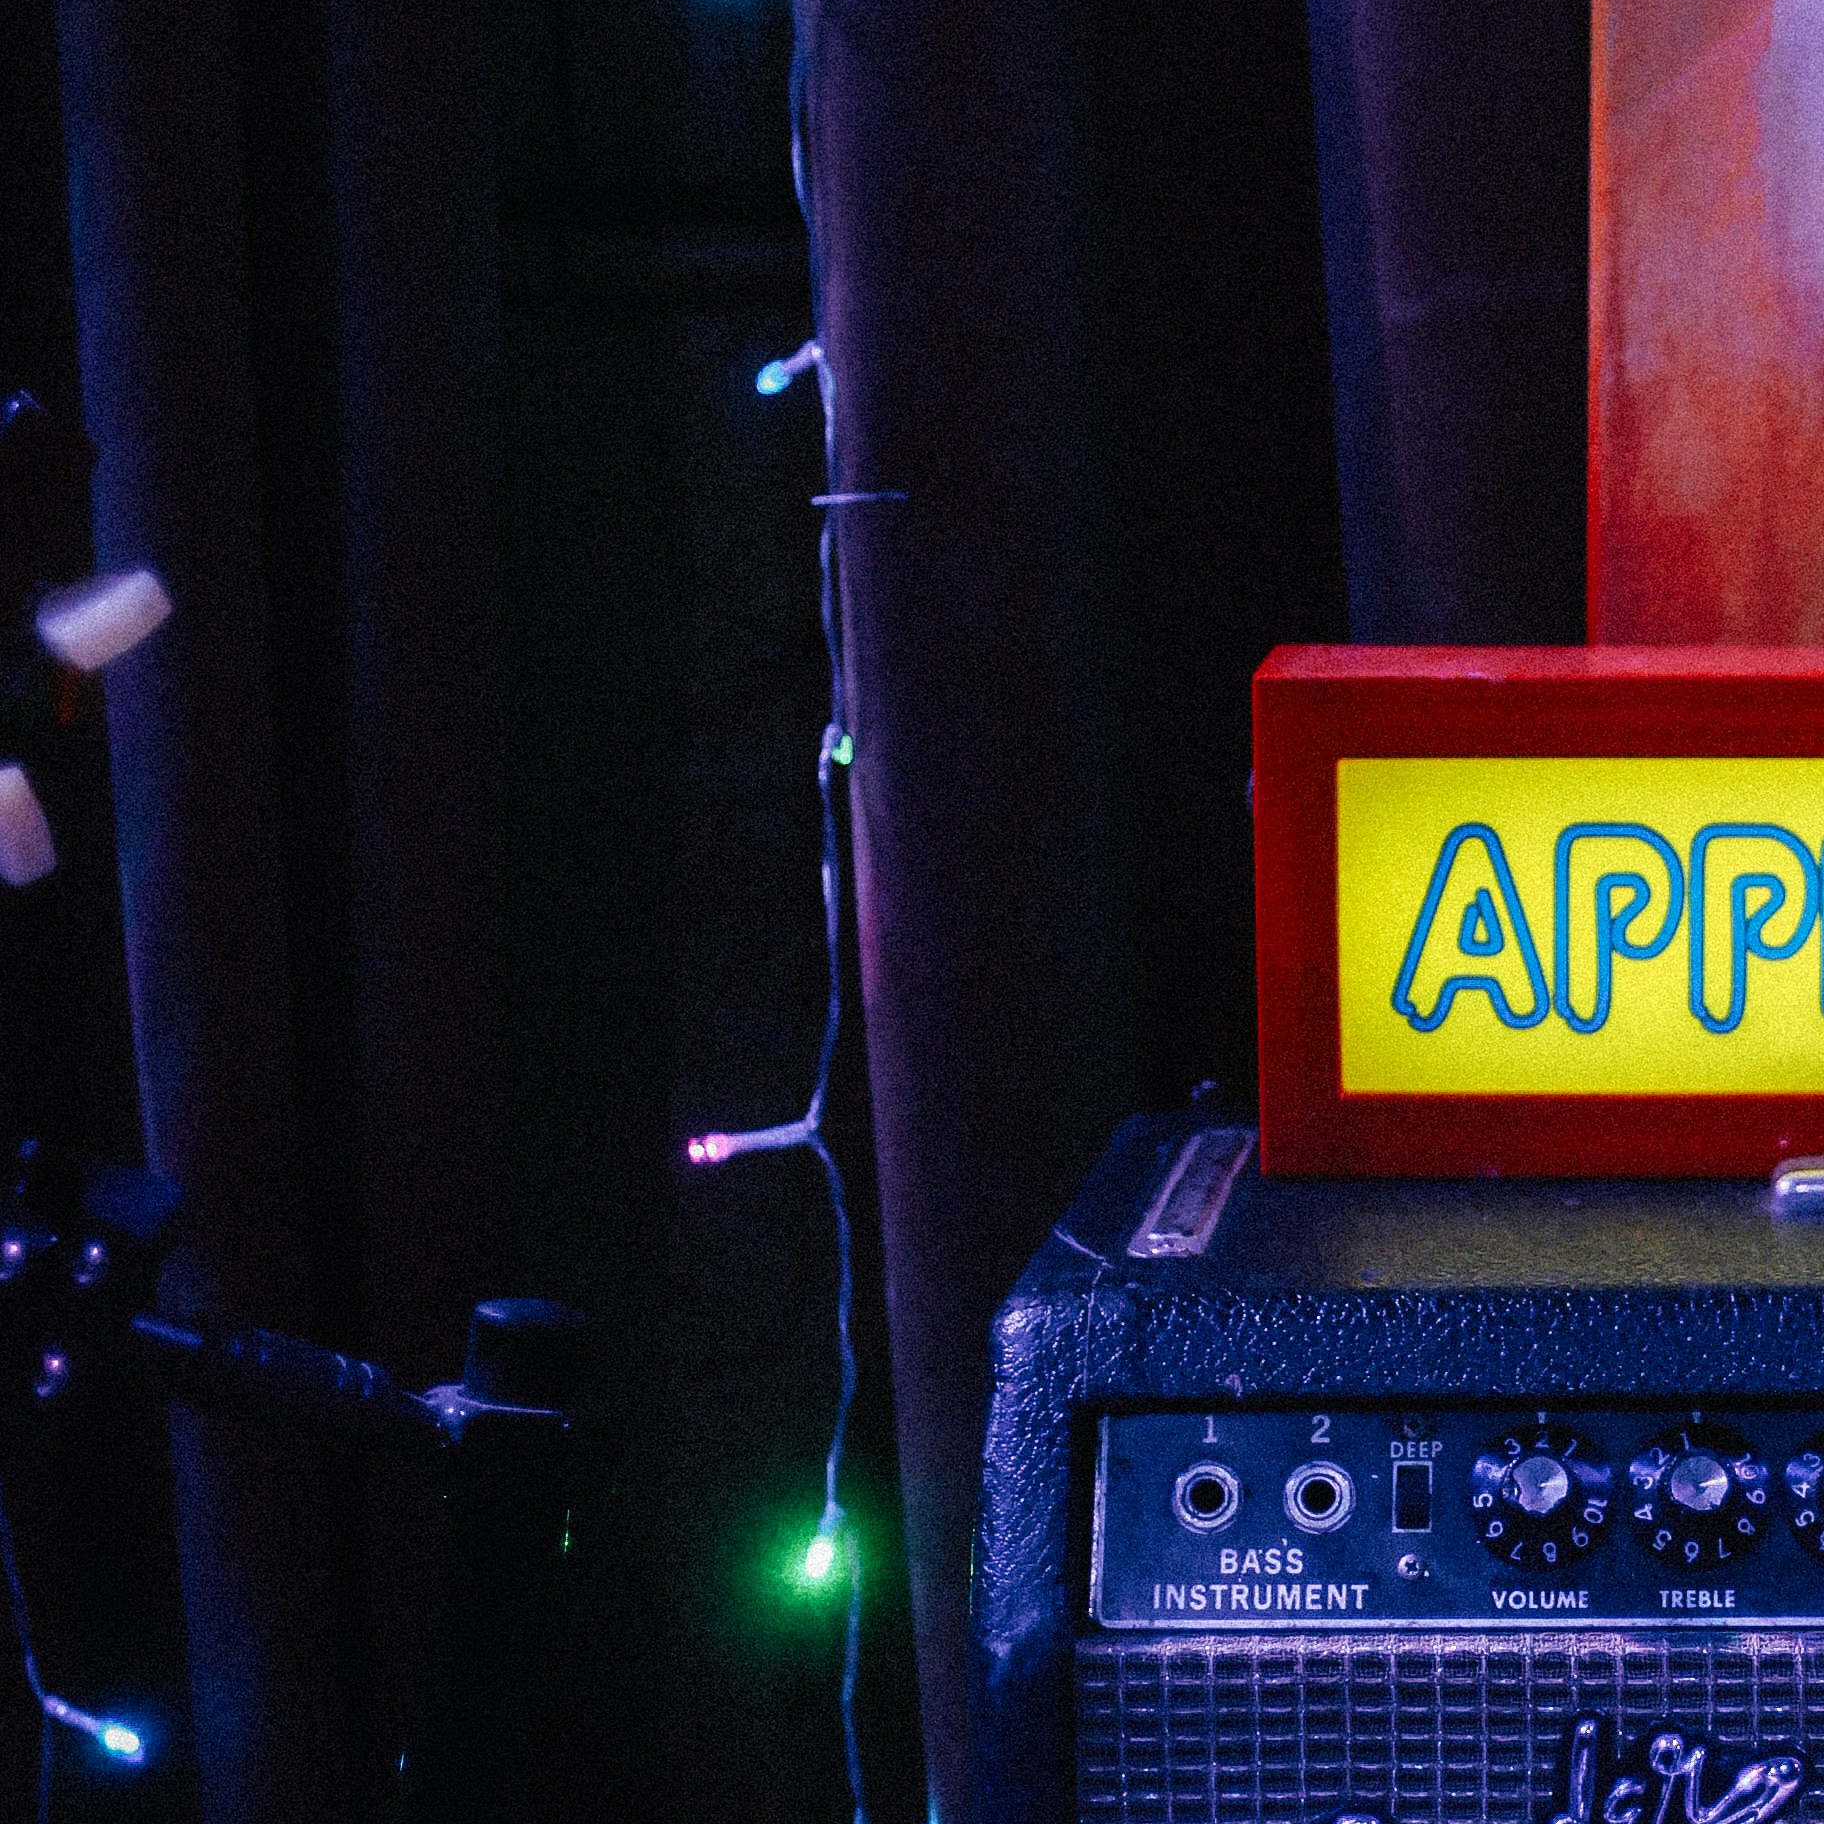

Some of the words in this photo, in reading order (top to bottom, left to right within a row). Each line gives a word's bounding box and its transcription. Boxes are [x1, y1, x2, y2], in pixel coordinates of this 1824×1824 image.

[1201, 1415, 1218, 1444] 1
[1310, 1414, 1332, 1444] 2
[1389, 1440, 1444, 1459] DEEP
[1219, 1547, 1305, 1576] BASS
[1152, 1583, 1370, 1611] INSTRUMENT
[1492, 1589, 1590, 1610] VOLUME
[1660, 1589, 1736, 1609] TREBLE
